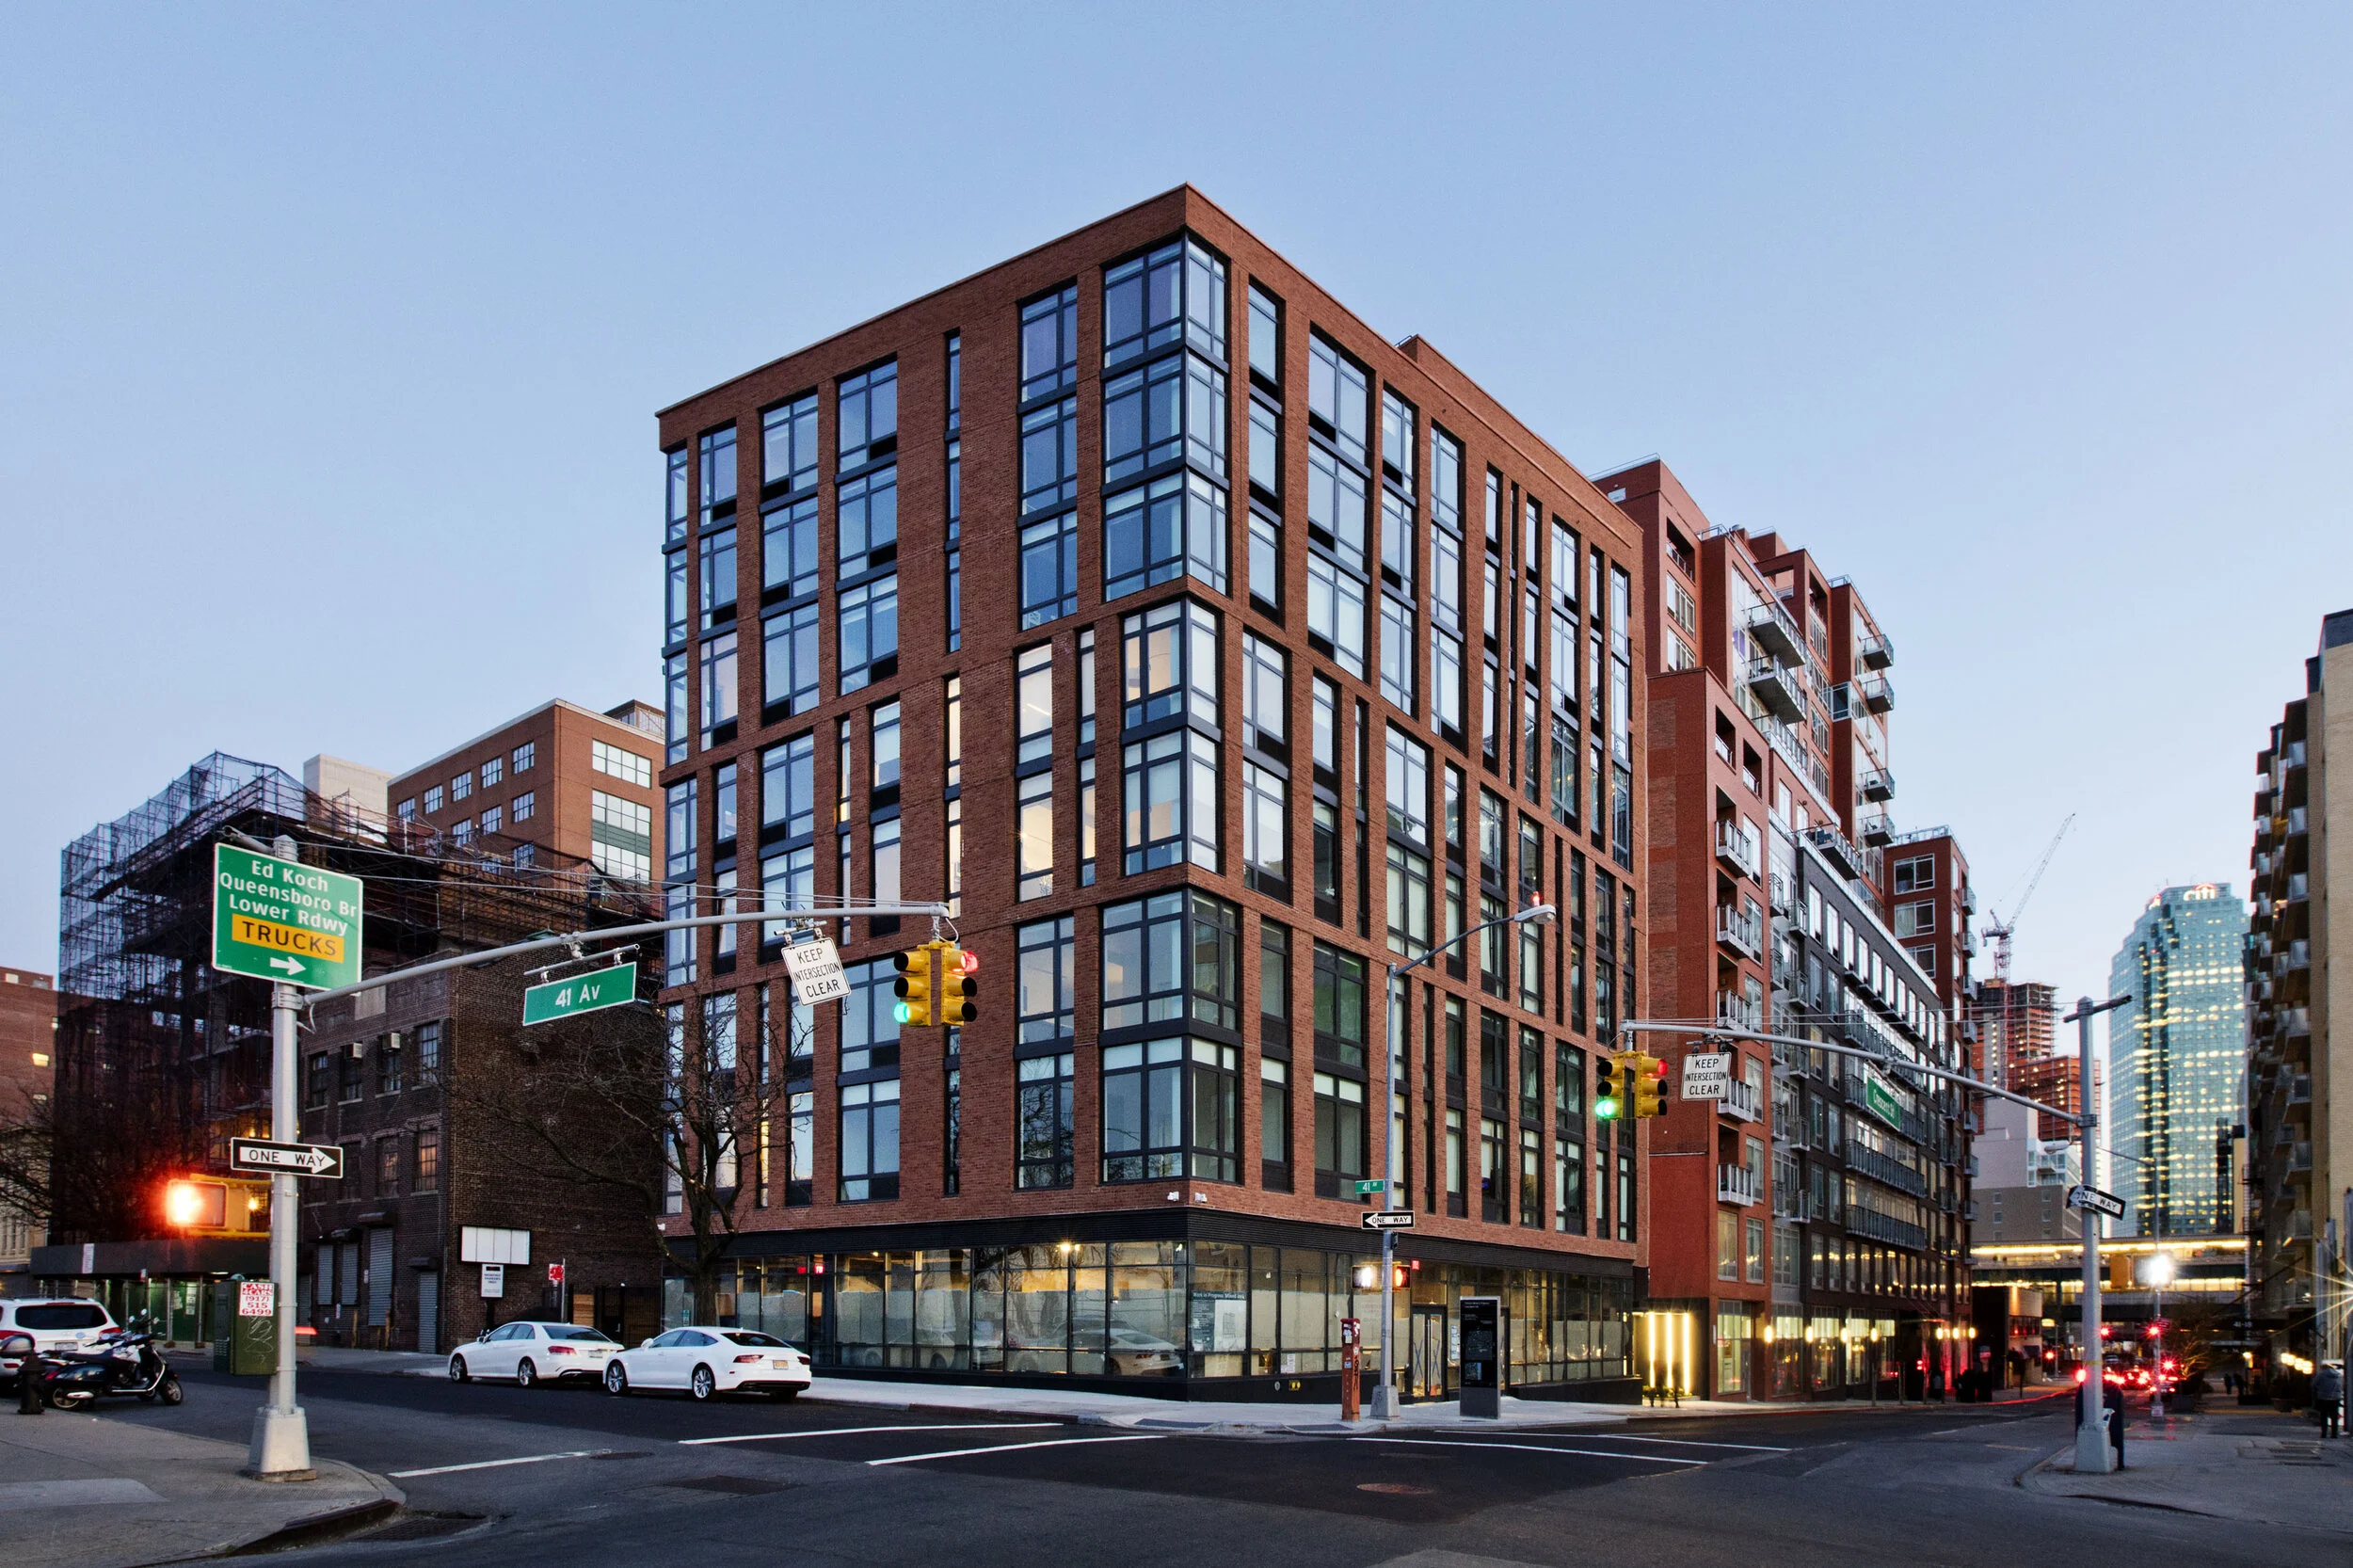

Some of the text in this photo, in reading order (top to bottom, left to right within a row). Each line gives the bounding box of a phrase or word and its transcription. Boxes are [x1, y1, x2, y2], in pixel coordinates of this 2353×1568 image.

[251, 860, 328, 892] Ed Koch
[219, 872, 357, 917] Queensboro Br
[229, 894, 347, 936] Lower Rdwy
[242, 921, 336, 956] TRUCKS
[796, 948, 823, 964] KEEP
[792, 962, 840, 983] INTERSECTION
[555, 984, 600, 1007] 41 Av
[806, 979, 840, 998] CLEAR
[1695, 1059, 1719, 1068] KEEP
[1685, 1071, 1726, 1081] INTERSECTION
[1689, 1085, 1720, 1095] CLEAR
[248, 1149, 325, 1166] ONE WAY
[1362, 1182, 1370, 1192] 41
[2099, 1197, 2117, 1210] WAY
